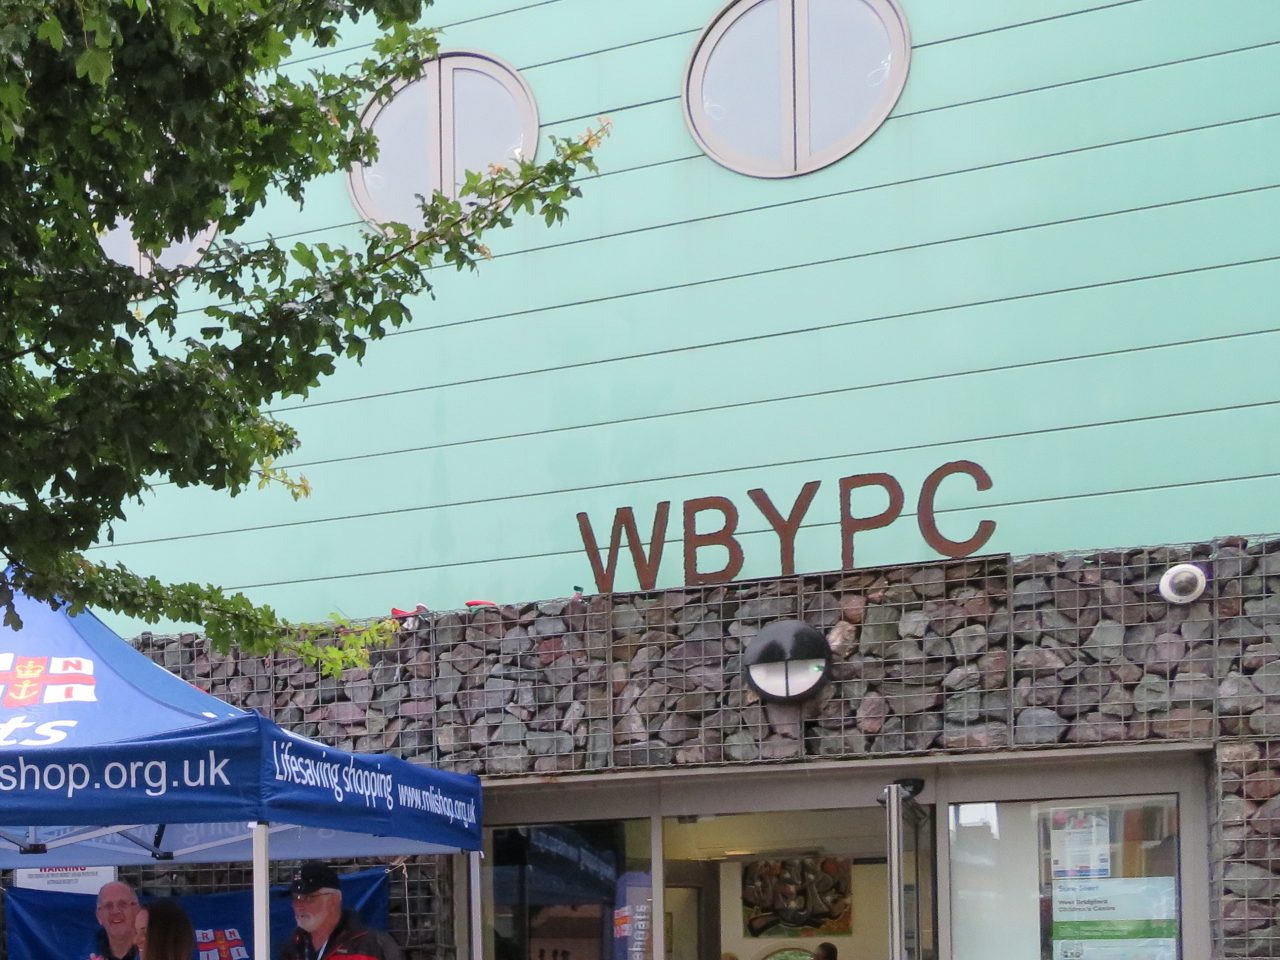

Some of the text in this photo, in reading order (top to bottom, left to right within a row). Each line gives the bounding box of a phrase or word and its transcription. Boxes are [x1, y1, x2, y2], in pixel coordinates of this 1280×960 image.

[576, 460, 996, 593] WBYPC
[272, 740, 477, 828] Lifesaving shopping www.rnlishop.org.uk
